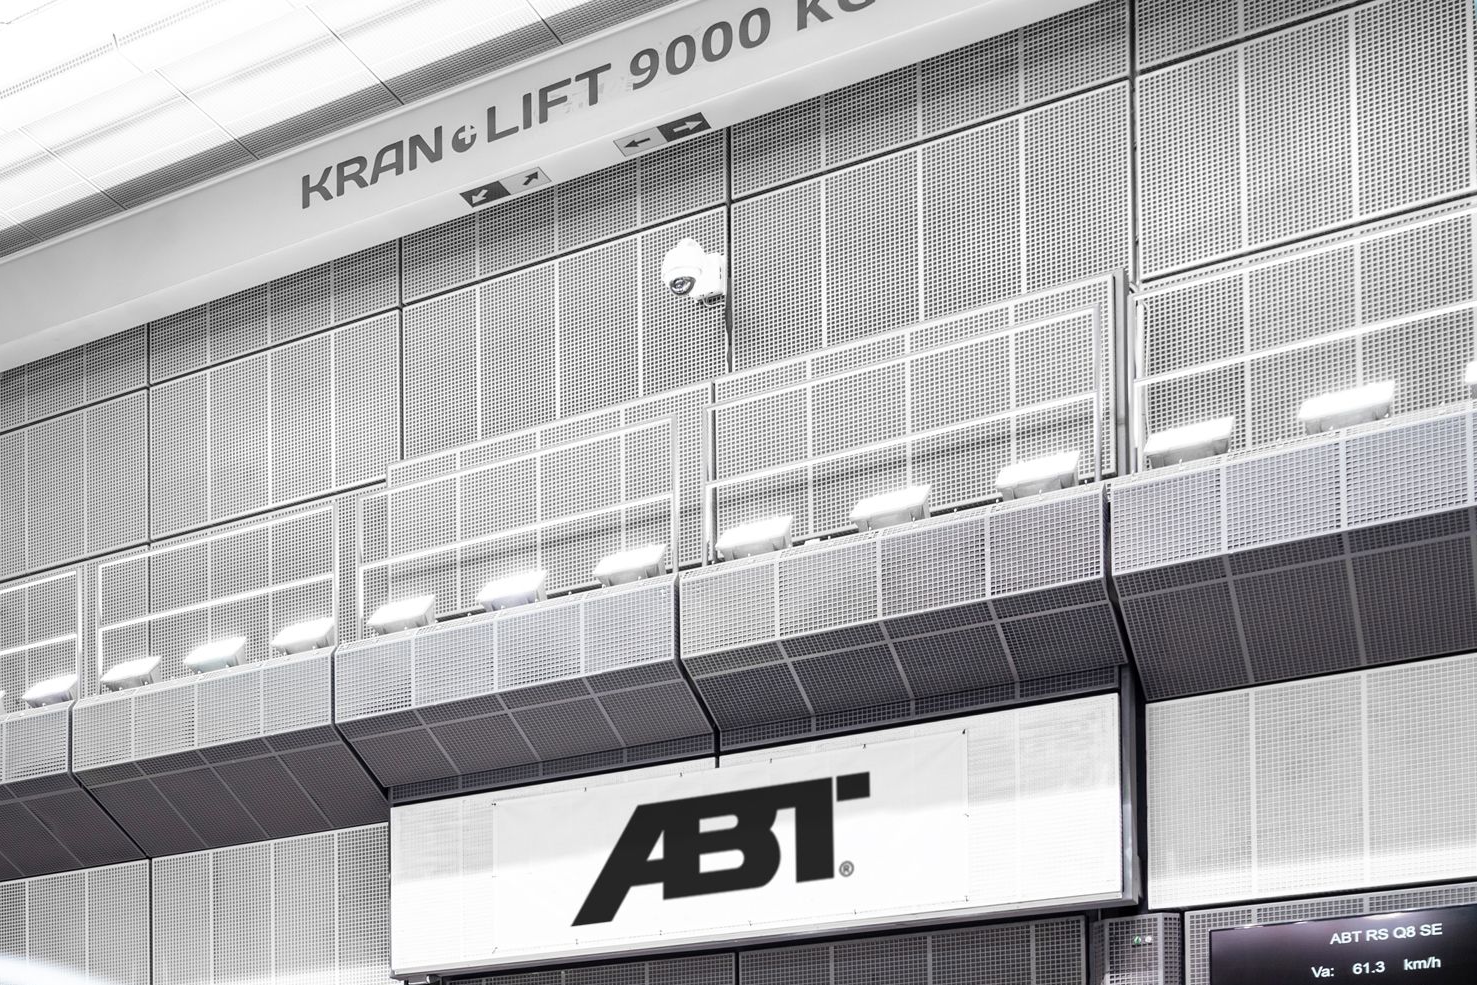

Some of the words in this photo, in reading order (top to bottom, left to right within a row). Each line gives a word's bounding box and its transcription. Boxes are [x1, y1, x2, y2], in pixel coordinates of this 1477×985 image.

[301, 124, 443, 210] KRAN
[486, 63, 612, 144] LIFT
[629, 7, 771, 91] 9000
[796, 0, 876, 32] K
[1329, 930, 1362, 945] ABT
[1365, 927, 1389, 942] RS
[1392, 924, 1416, 939] Q8
[1419, 923, 1443, 937] SE
[1311, 966, 1334, 977] Va:
[1353, 961, 1385, 974] 61.3
[1404, 957, 1441, 970] km/h
